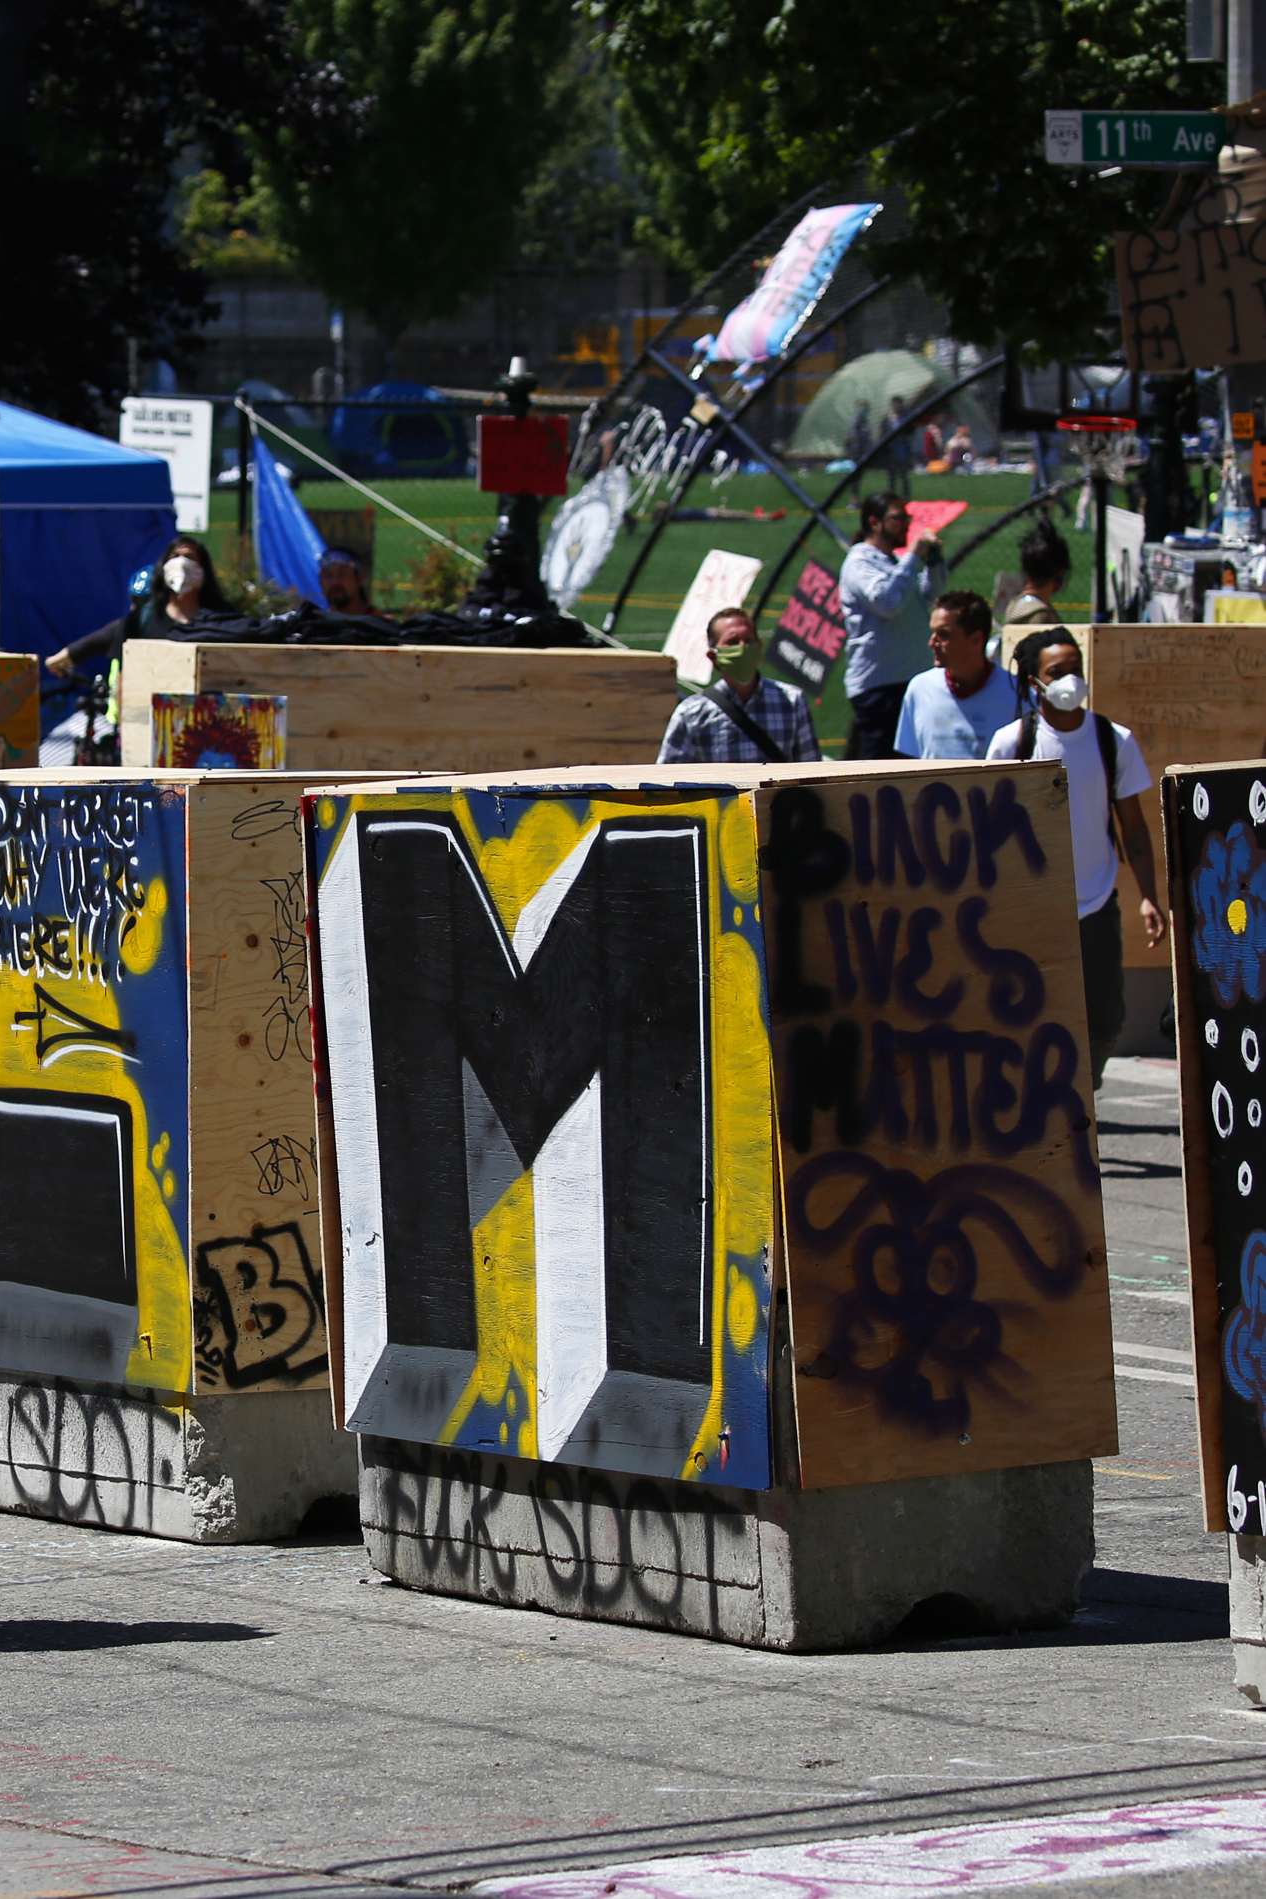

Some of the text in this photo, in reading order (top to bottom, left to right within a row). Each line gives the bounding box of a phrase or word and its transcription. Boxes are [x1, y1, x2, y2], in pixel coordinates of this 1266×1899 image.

[1049, 129, 1080, 140] ARTS
[1096, 118, 1217, 157] 11th Ave
[61, 786, 157, 847] FORGET
[772, 894, 1046, 1026] LIVES
[354, 806, 716, 1395] M
[780, 1018, 1098, 1160] MATTER
[385, 1450, 517, 1593] FUCK
